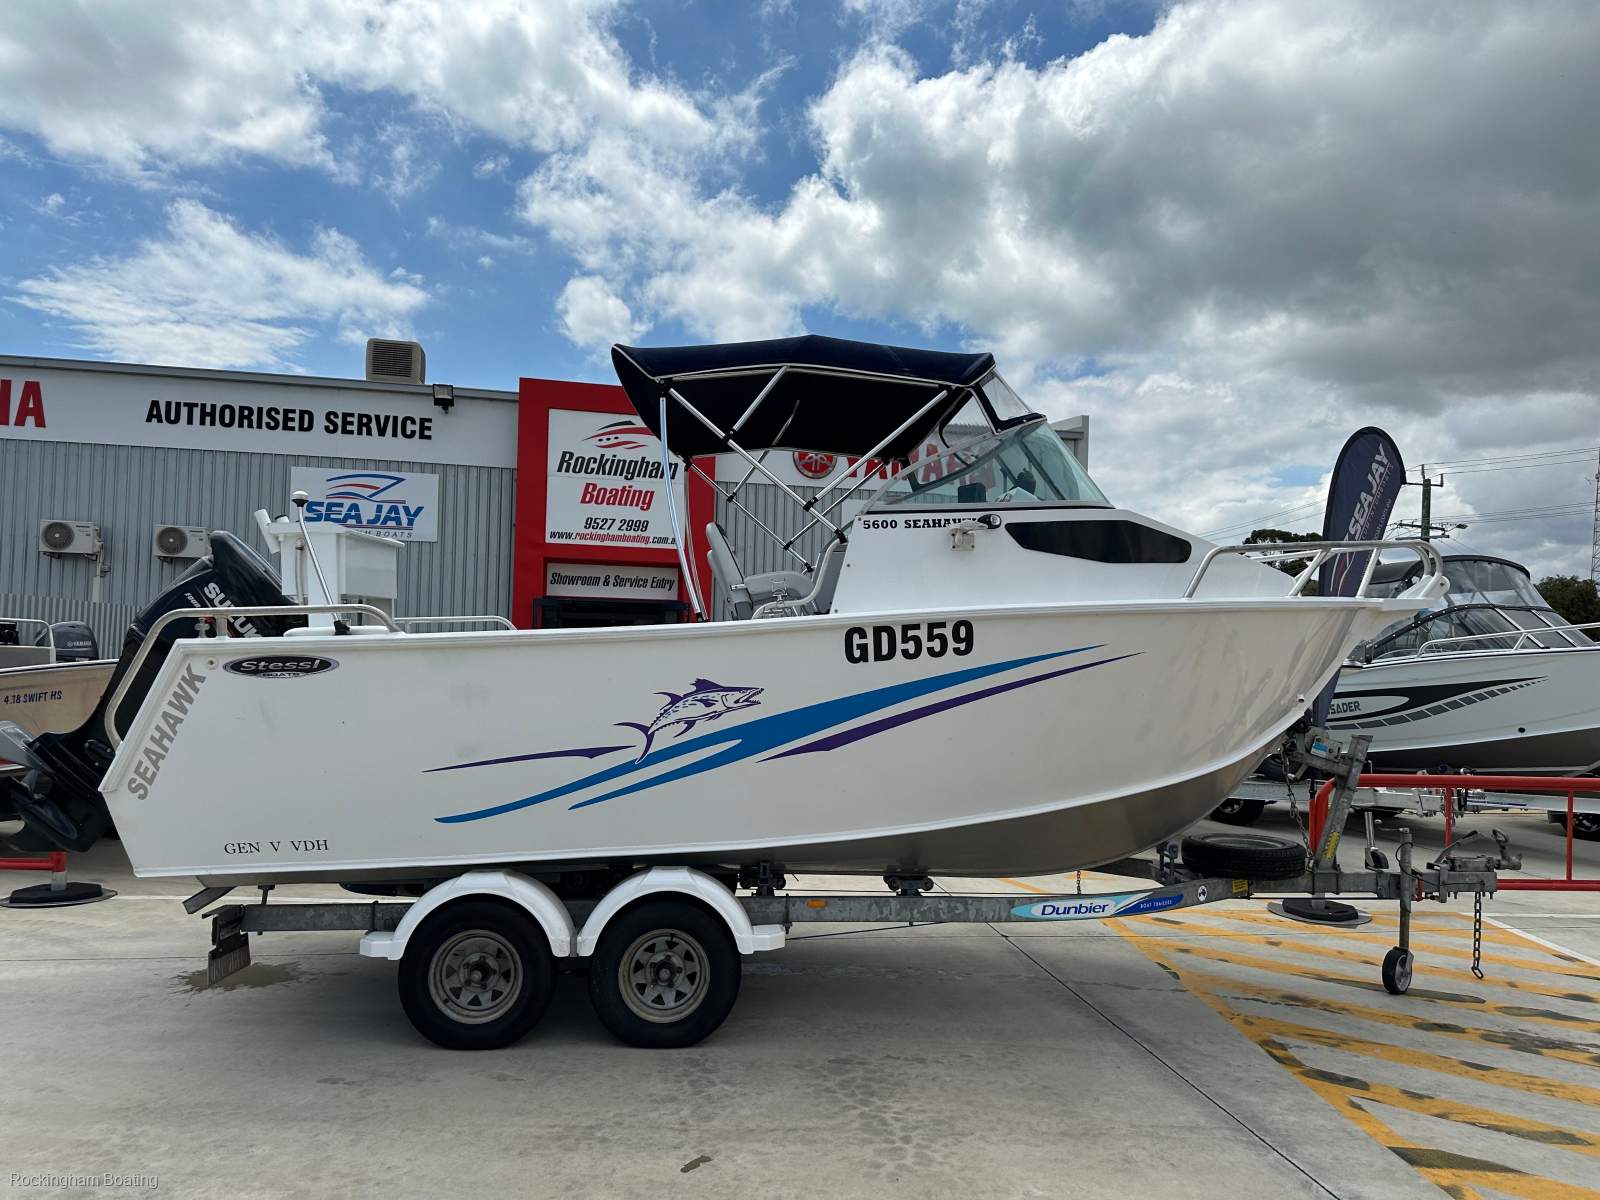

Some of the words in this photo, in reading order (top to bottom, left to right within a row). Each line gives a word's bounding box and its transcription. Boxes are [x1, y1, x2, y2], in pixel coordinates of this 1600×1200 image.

[145, 399, 315, 432] AUTHORISED
[323, 410, 433, 440] SERVICE
[556, 450, 679, 481] Rockingham
[580, 482, 656, 511] Boating
[1348, 491, 1374, 541] SEA
[1367, 443, 1389, 496] JAY
[304, 500, 363, 525] SEA
[366, 502, 424, 527] JAY
[583, 516, 617, 531] 9527
[618, 518, 650, 533] 2999
[862, 519, 898, 530] 5600
[903, 517, 977, 529] SEAHA
[549, 530, 679, 545] www.rockinghamboating.com.a
[549, 571, 601, 587] Showroom
[602, 574, 611, 587] &
[612, 574, 649, 589] Service
[650, 576, 675, 591] Entry
[844, 619, 974, 664] GD559
[22, 691, 48, 703] SWIFT
[50, 690, 63, 700] HS
[127, 663, 206, 800] SEAHAWK
[224, 841, 261, 855] GEN
[268, 840, 281, 852] V
[290, 839, 329, 852] VDH
[1041, 903, 1109, 916] Dunbier
